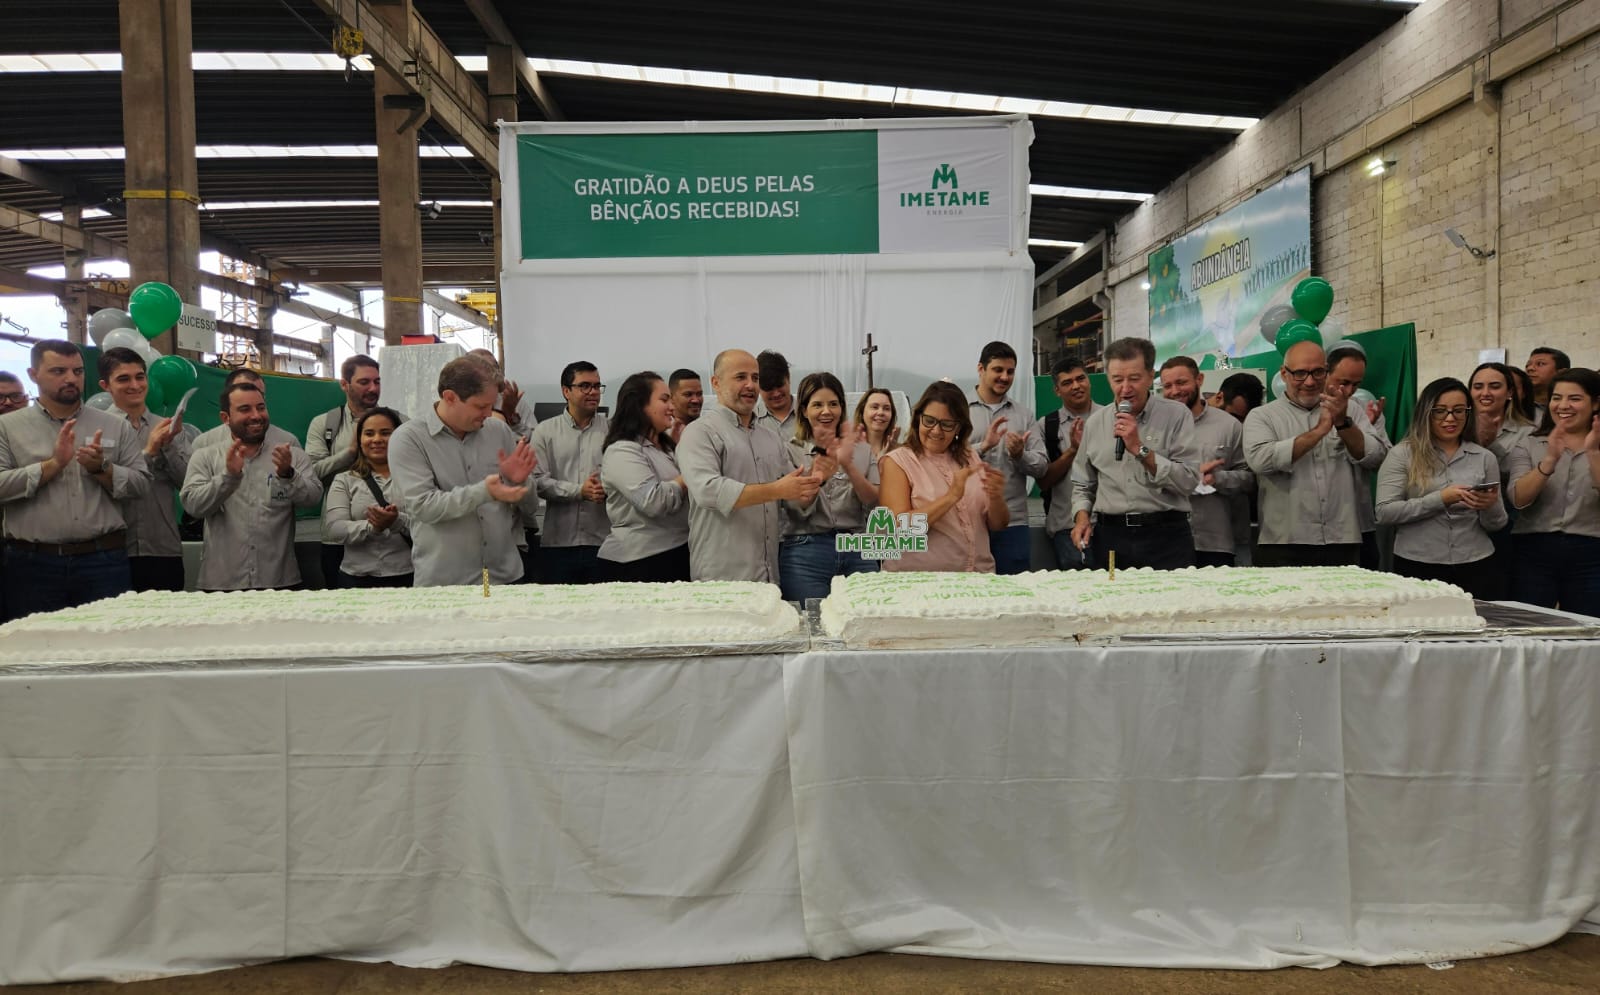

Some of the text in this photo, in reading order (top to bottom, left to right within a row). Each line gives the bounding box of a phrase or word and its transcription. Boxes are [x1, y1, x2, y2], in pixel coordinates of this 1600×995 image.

[574, 174, 815, 195] GRATIDÃO A DEUS PELAS
[900, 191, 990, 207] IMETAME
[590, 199, 799, 225] BÊNÇÃOS RECEBIDAS!
[1191, 237, 1251, 292] ABUNDÂNCIA
[179, 315, 217, 331] SUCESSO
[897, 513, 928, 535] 15
[836, 535, 928, 552] IMETAME
